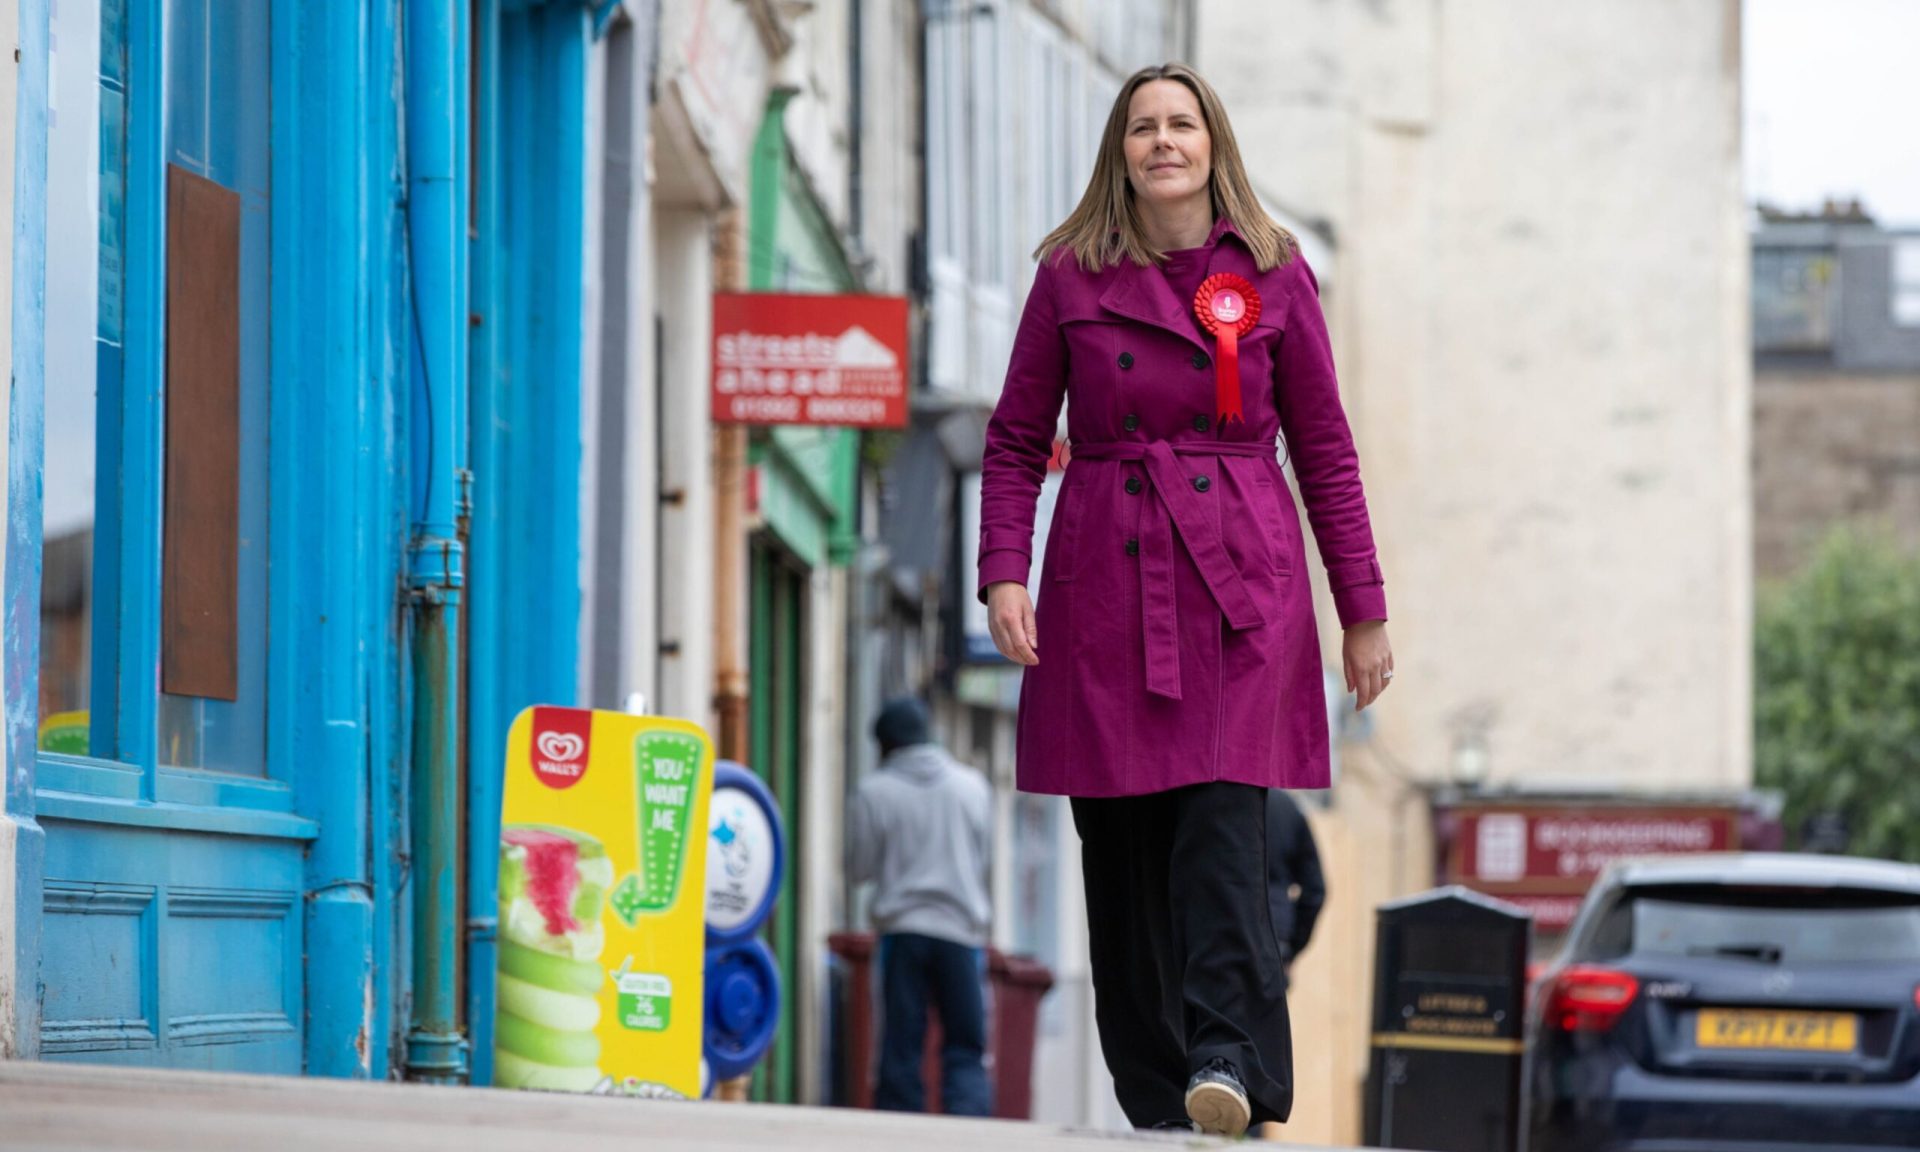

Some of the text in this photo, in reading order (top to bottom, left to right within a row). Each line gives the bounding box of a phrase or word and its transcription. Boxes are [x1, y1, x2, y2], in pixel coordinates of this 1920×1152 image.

[717, 368, 841, 394] ahead
[538, 761, 581, 776] WALL'S
[653, 758, 685, 779] YOU
[645, 784, 687, 806] WANT
[652, 810, 676, 831] ME
